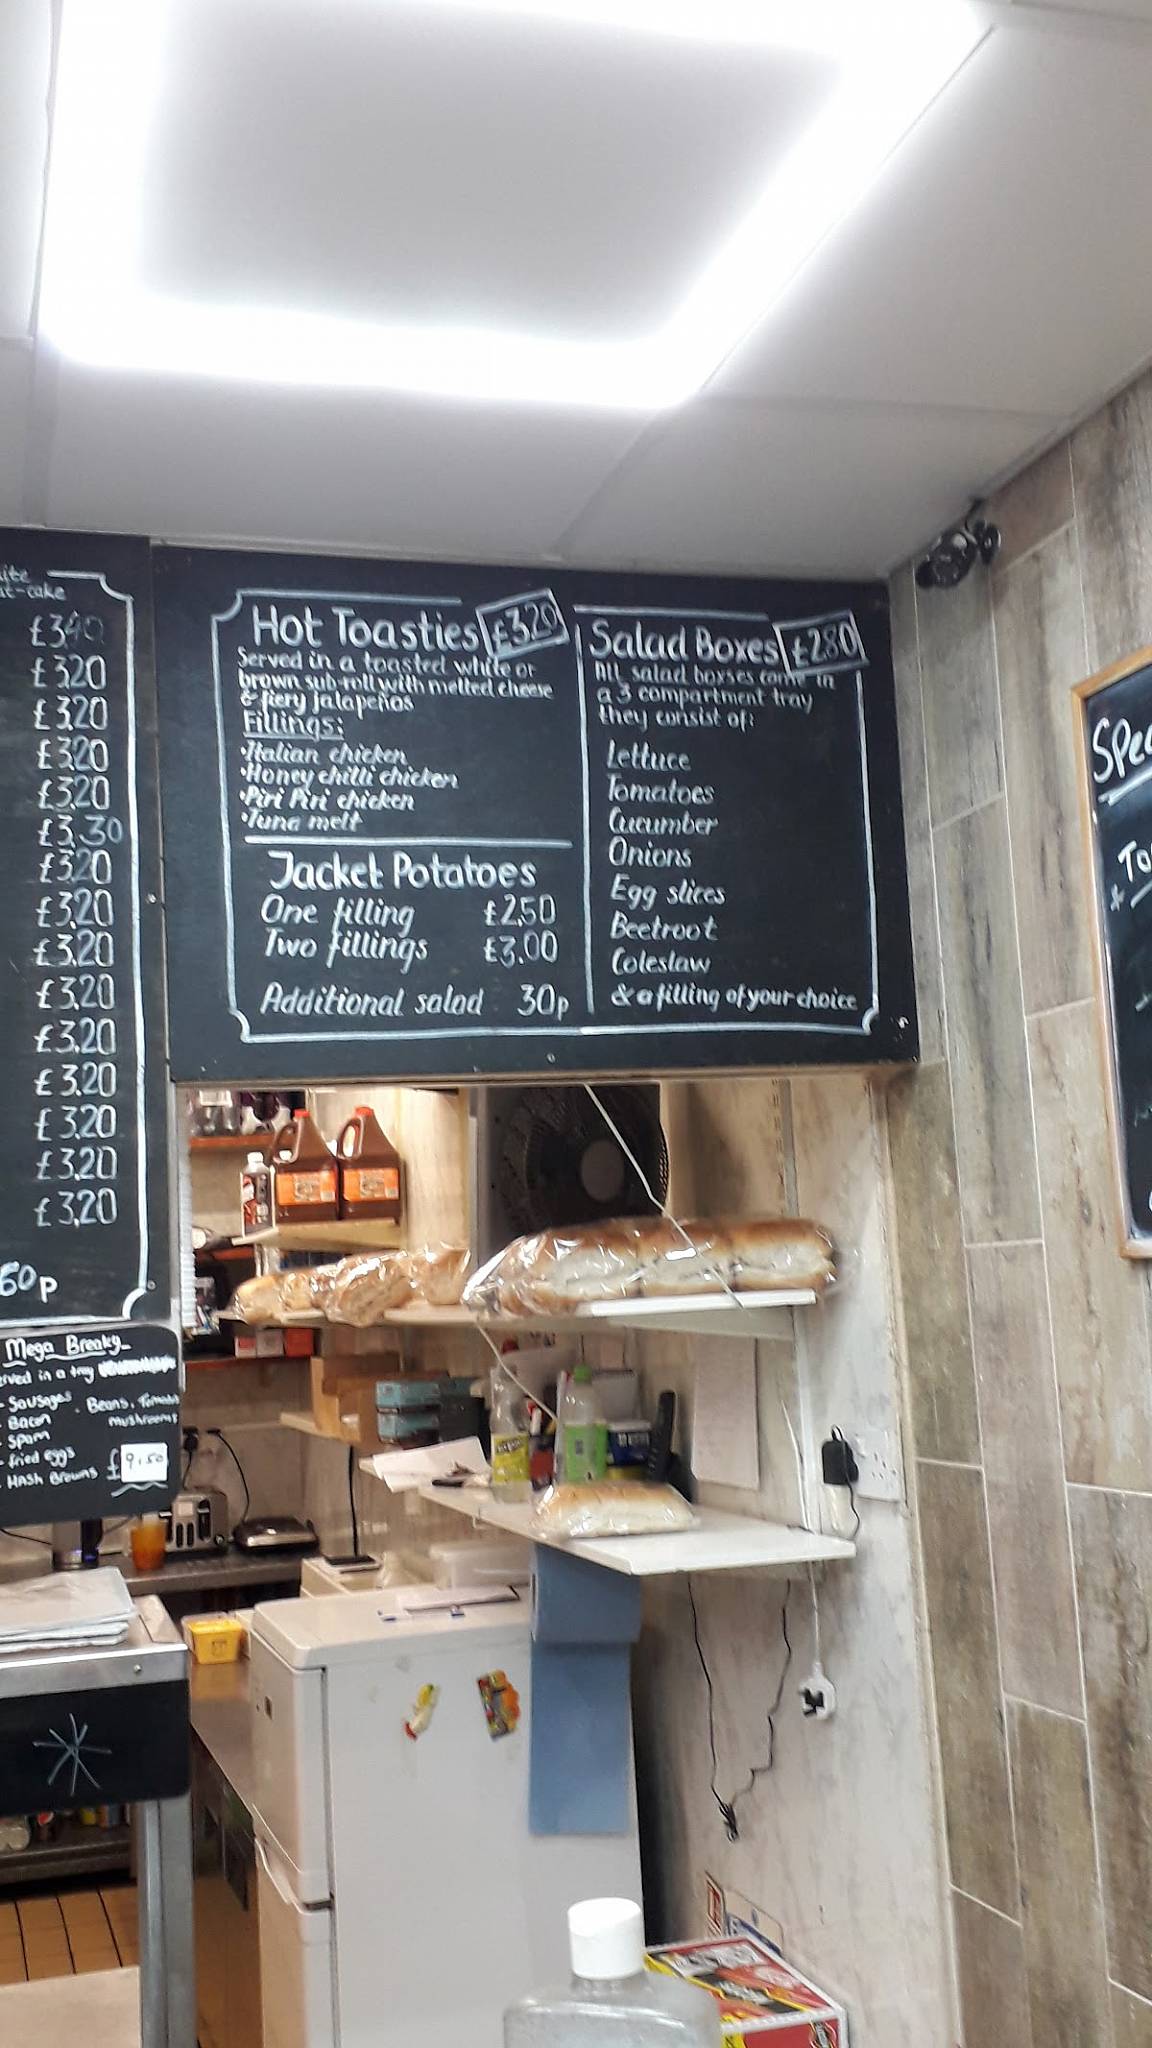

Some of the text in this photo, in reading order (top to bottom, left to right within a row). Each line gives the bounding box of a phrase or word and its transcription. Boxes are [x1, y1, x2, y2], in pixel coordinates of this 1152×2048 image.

[252, 604, 479, 651] Hot Toasties
[590, 618, 779, 664] Salad Boxes
[238, 646, 537, 679] Served in a toasted white or
[595, 661, 622, 683] All
[631, 664, 687, 684] salad
[816, 672, 836, 690] in
[238, 668, 303, 691] brown
[377, 674, 425, 695] with
[428, 677, 495, 697] melted
[239, 688, 258, 707] &
[261, 689, 307, 716] fiery
[597, 686, 611, 703] a
[638, 685, 766, 710] compartment
[773, 688, 813, 714] tray
[600, 704, 649, 733] they
[656, 708, 720, 728] consist
[329, 742, 408, 766] chicken
[607, 739, 692, 771] Lettuce
[246, 763, 460, 791] Honey chilli chicken
[607, 773, 715, 805] Tomatoes
[245, 785, 415, 812] Piri Piri chicken
[248, 807, 363, 832] Tuna melt
[608, 806, 719, 836] Cucumber
[608, 836, 692, 867] Onions
[1117, 840, 1152, 882] To
[267, 850, 537, 891] Jacket Potatoes
[610, 873, 727, 911] Egg slices
[261, 893, 557, 937] One filling £2.50
[610, 910, 719, 941] Beetroot
[264, 927, 558, 974] Two fillings £3.00
[611, 947, 712, 976] Coleslaw
[260, 981, 570, 1021] Additional salad 30p
[611, 982, 858, 1012] & a filling of your choice
[5, 1337, 54, 1363] Mega
[38, 1369, 52, 1381] in
[55, 1369, 66, 1379] a
[70, 1365, 95, 1384] tray
